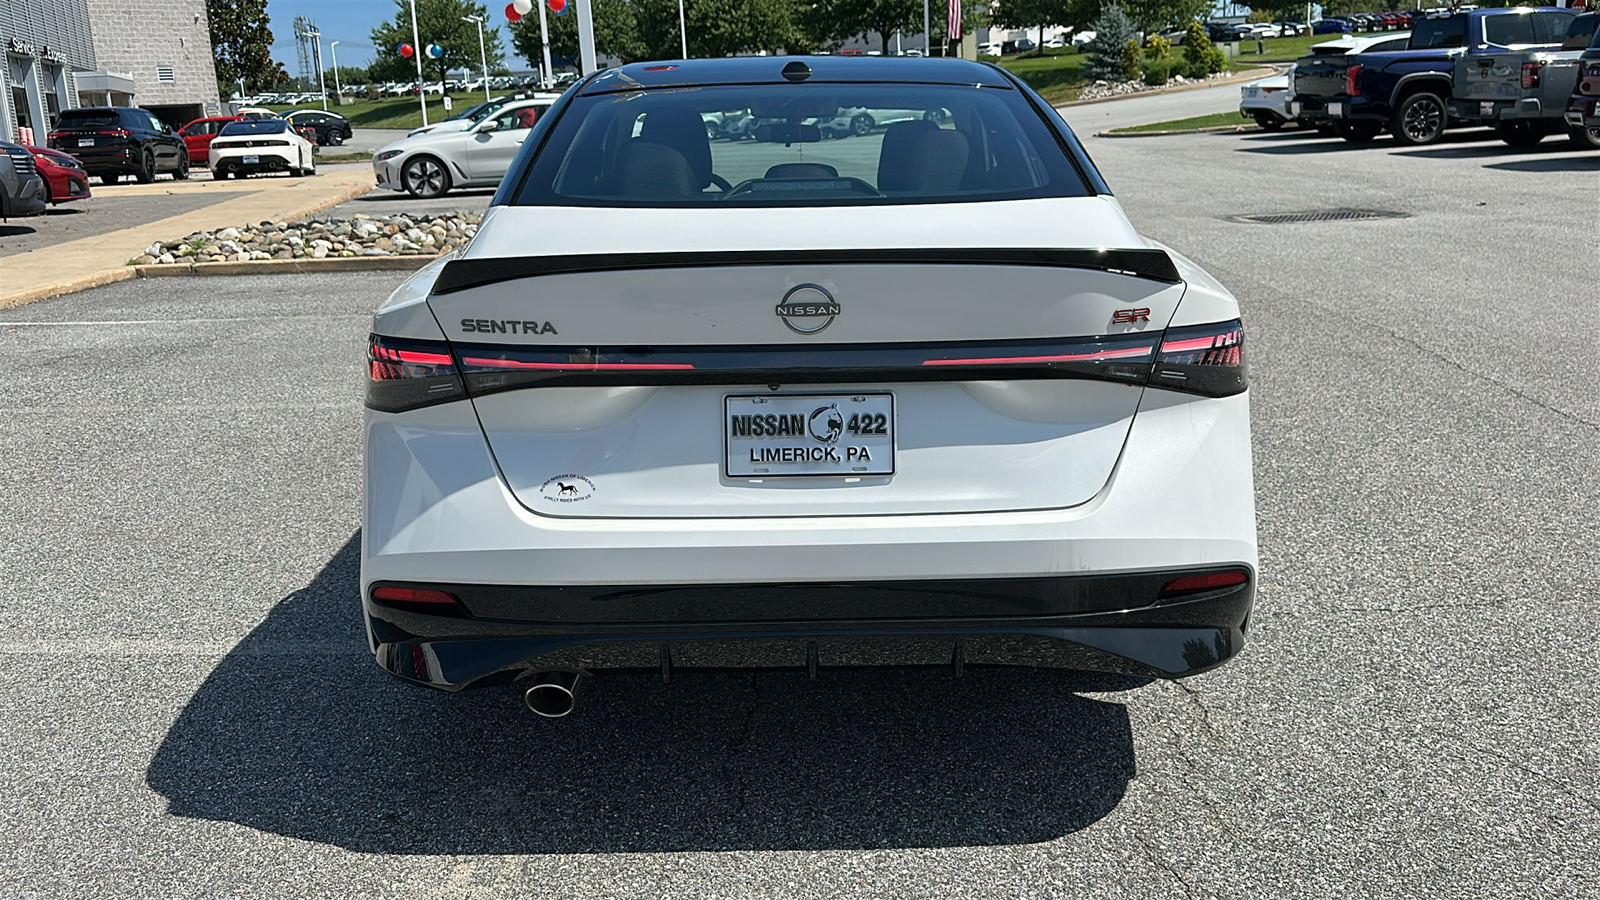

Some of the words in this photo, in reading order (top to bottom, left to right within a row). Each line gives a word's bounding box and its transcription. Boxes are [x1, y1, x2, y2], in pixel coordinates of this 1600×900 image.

[777, 306, 839, 315] NISSAN
[1112, 307, 1151, 325] SR
[460, 319, 558, 335] SENTRA
[731, 414, 806, 438] NISSAN
[847, 412, 888, 436] 422
[750, 448, 841, 463] LIMERICK,
[847, 447, 871, 461] PA
[540, 479, 551, 492] BUSH
[550, 473, 569, 482] NISSAN
[577, 474, 597, 492] LIMERICK
